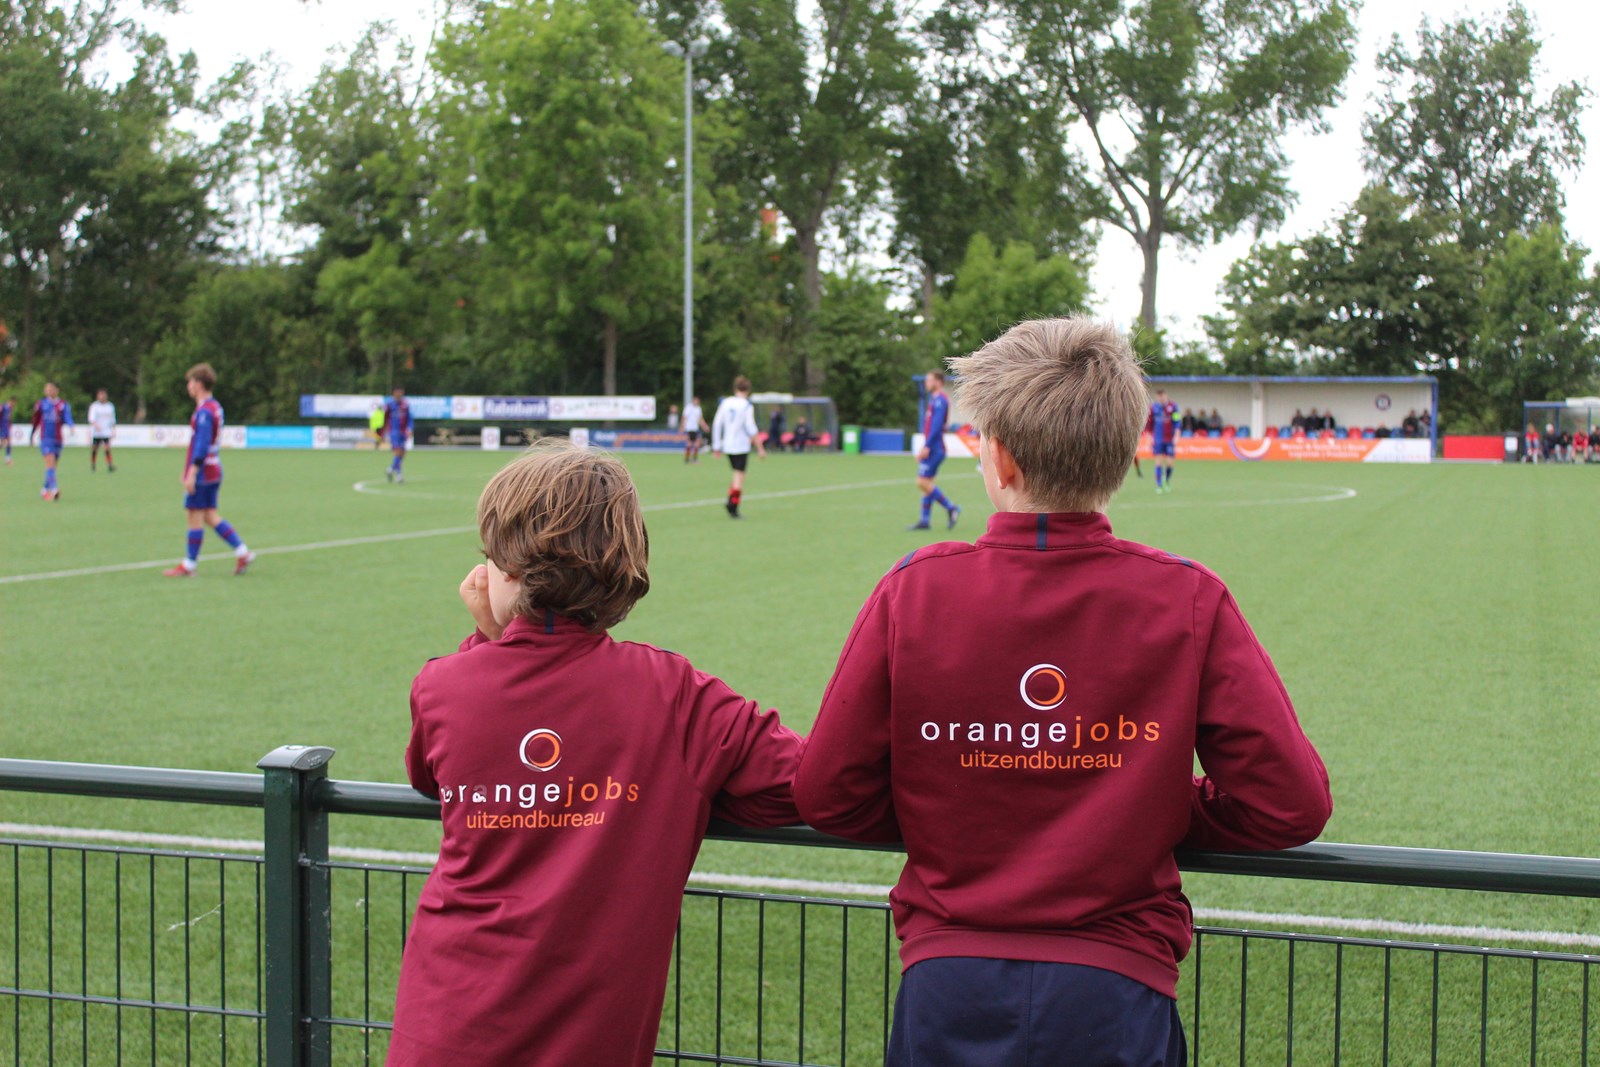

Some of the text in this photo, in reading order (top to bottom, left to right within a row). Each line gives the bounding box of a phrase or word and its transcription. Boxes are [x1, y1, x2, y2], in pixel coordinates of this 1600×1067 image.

[921, 715, 1160, 748] orangejobs
[960, 750, 1122, 769] uitzendbureau
[466, 811, 605, 829] uitzendbureau
